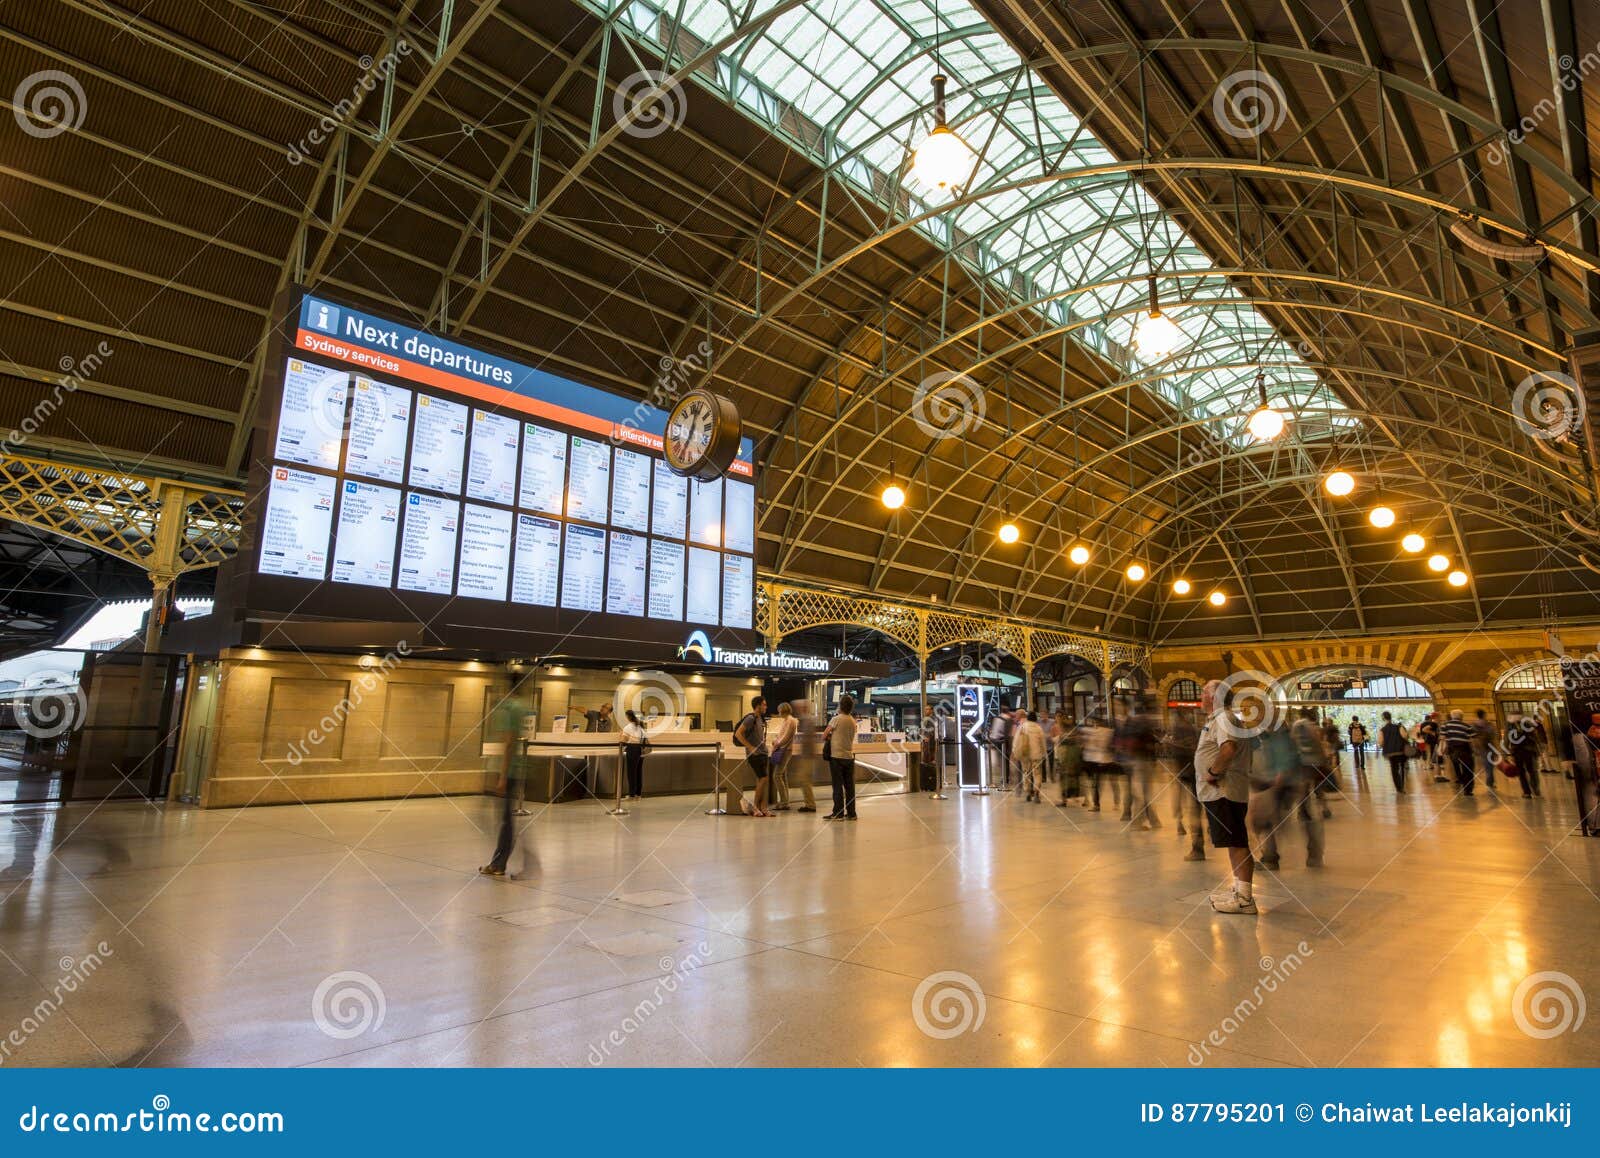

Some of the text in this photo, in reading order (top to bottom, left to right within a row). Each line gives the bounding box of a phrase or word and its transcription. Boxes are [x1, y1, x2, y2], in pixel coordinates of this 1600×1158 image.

[304, 335, 399, 372] Sydney services
[346, 316, 513, 384] Next departures
[620, 428, 652, 447] Intercity
[730, 462, 749, 473] rvices
[289, 471, 316, 481] Lidcombe
[320, 498, 331, 506] 22
[713, 647, 829, 671] Transport Information
[960, 709, 978, 718] Entry
